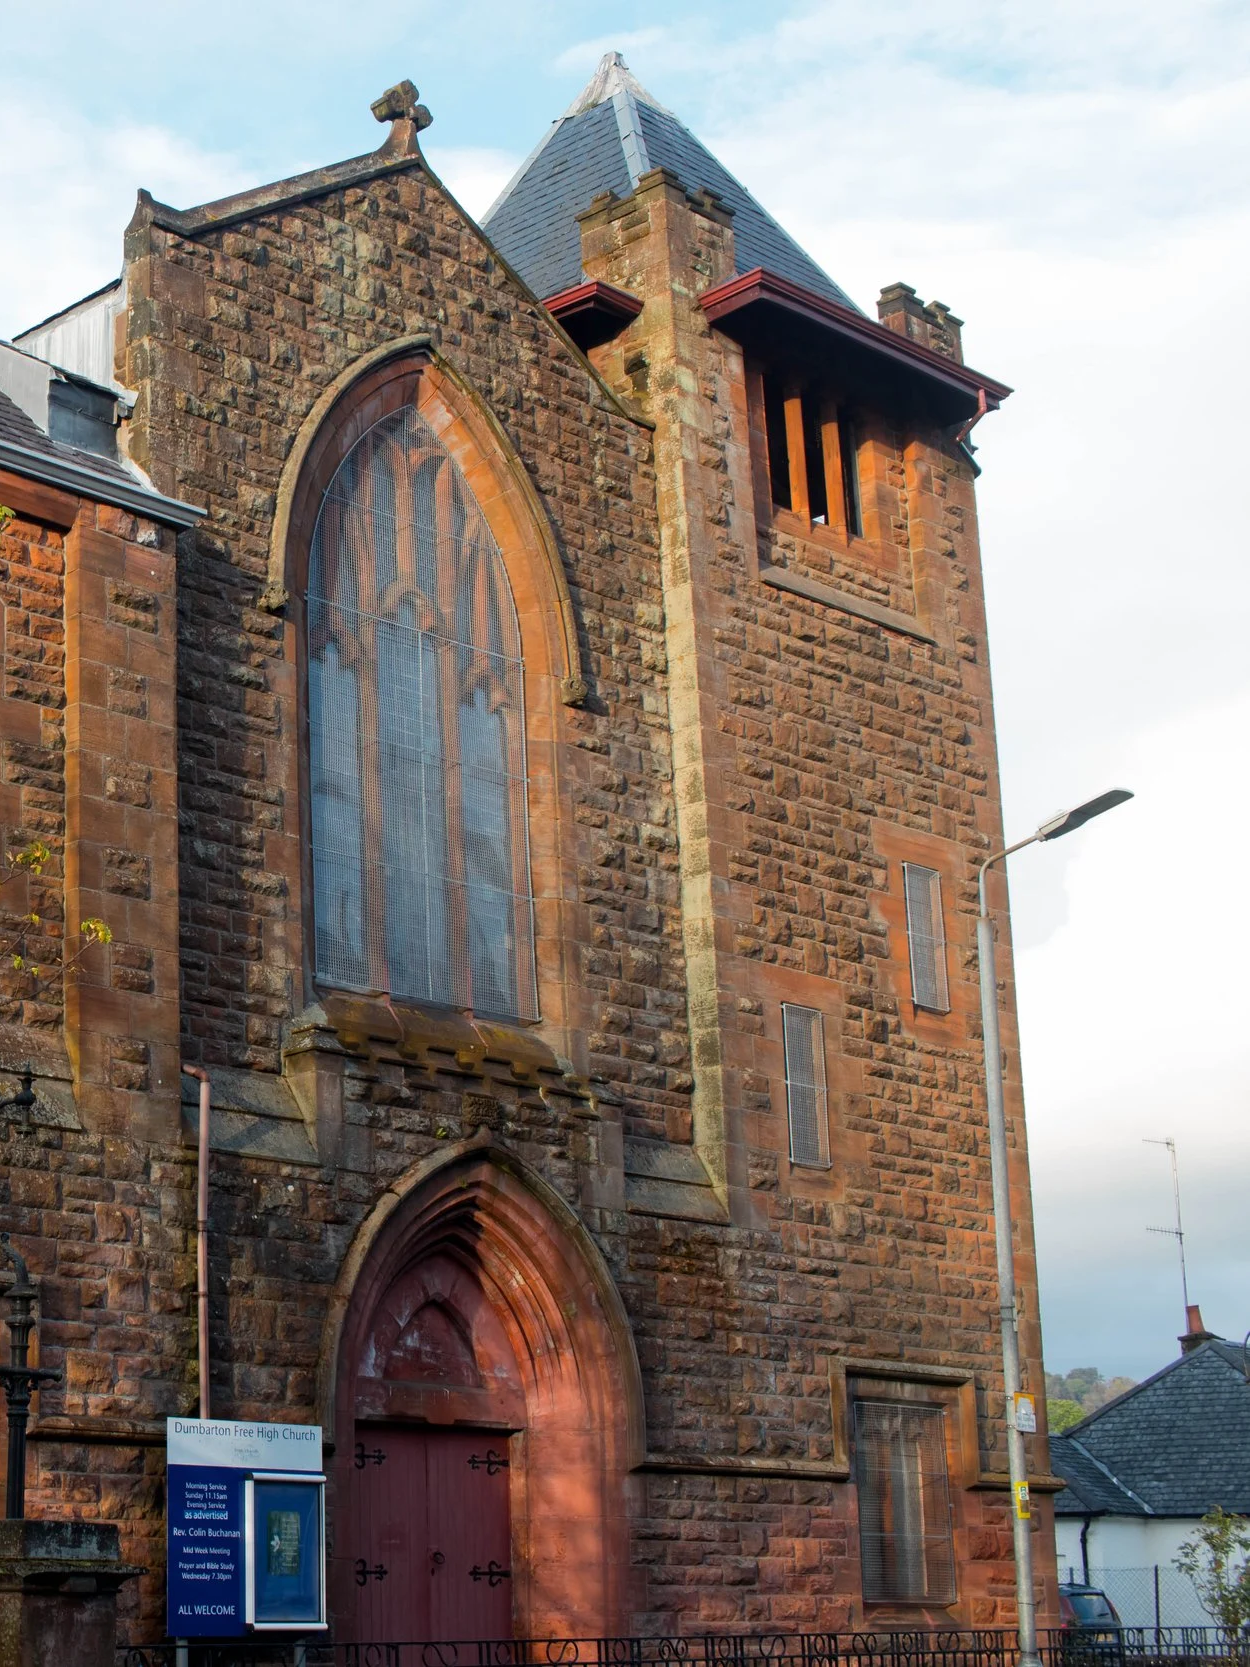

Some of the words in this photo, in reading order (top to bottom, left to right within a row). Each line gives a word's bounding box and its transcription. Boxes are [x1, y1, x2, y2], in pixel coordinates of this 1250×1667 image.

[174, 1421, 231, 1437] Dumbarton
[234, 1425, 254, 1438] Free
[257, 1427, 279, 1442] High
[282, 1428, 316, 1441] Church
[185, 1482, 208, 1491] Morning
[209, 1483, 227, 1491] Service
[185, 1491, 204, 1500] Sunday
[205, 1492, 228, 1500] 11.15am
[186, 1501, 207, 1510] Evening
[208, 1501, 226, 1509] Service
[193, 1510, 229, 1520] advertised
[173, 1527, 187, 1536] Rev.
[188, 1527, 207, 1537] Colin
[208, 1528, 241, 1538] Buchanan
[182, 1546, 194, 1554] Mid
[209, 1547, 231, 1556] Meeting
[178, 1562, 195, 1571] Prayer
[206, 1562, 220, 1570] Bible
[220, 1563, 235, 1571] Study
[181, 1572, 211, 1581] Wednesday
[211, 1573, 232, 1581] 7.30pm
[178, 1606, 192, 1615] ALL
[194, 1606, 236, 1616] WELCOME
